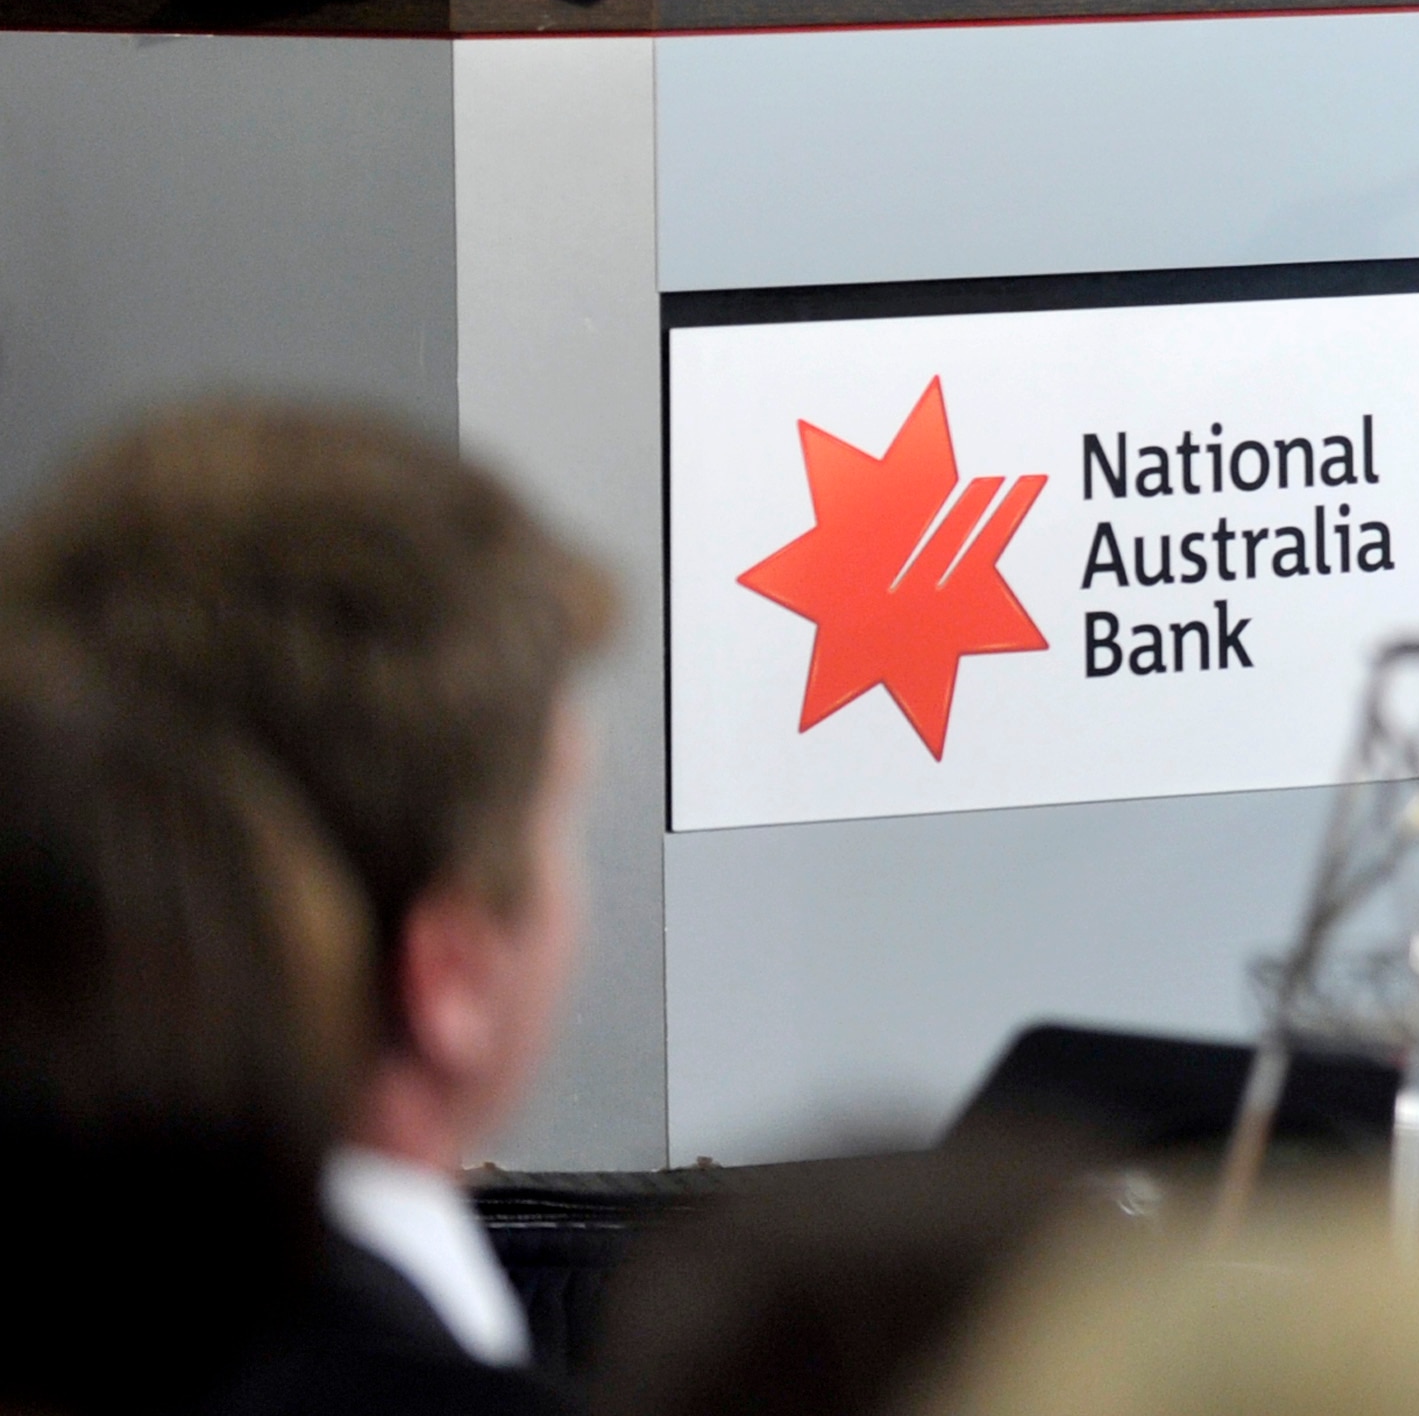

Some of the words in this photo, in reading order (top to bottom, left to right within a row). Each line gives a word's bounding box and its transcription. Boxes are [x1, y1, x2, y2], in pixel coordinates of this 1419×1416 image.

[1082, 413, 1380, 501] National
[1080, 502, 1396, 591] Australia
[1084, 598, 1255, 679] Bank
